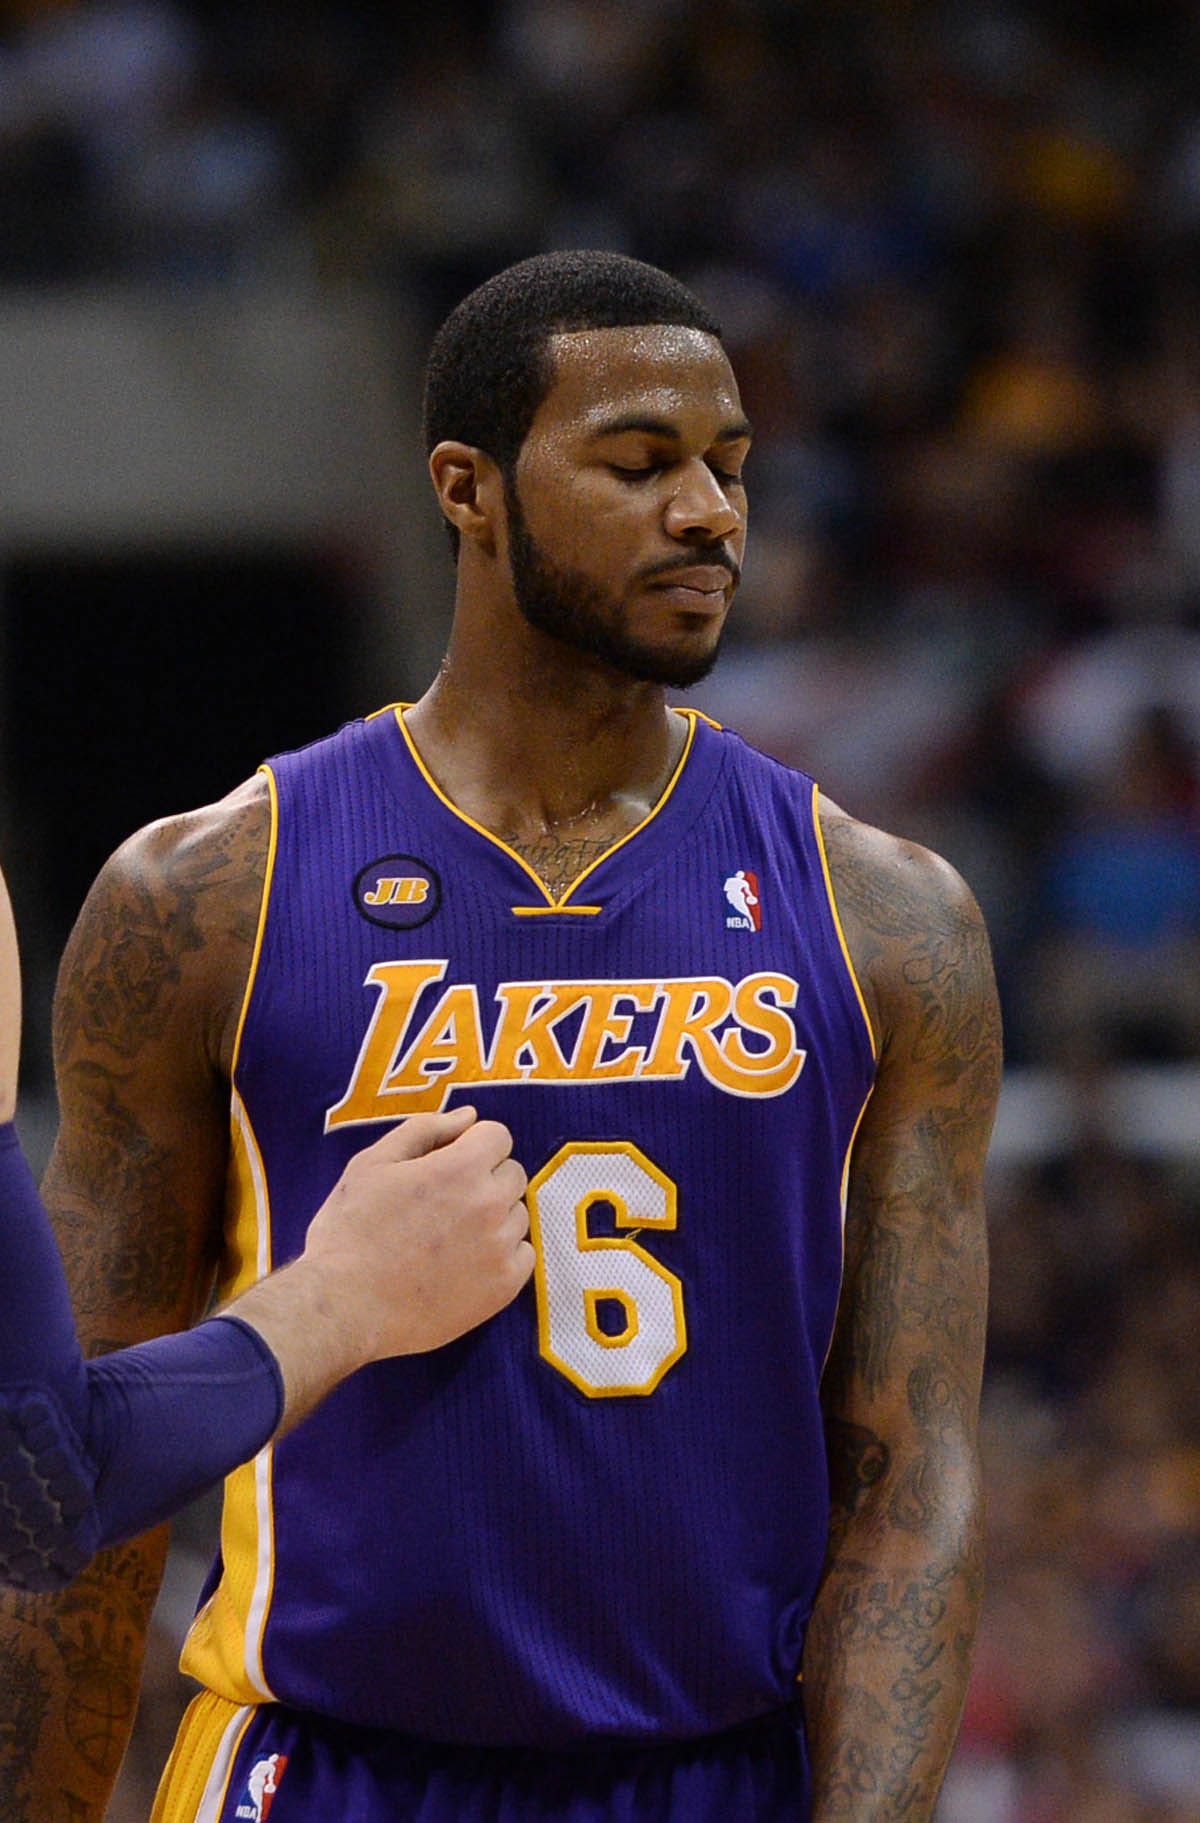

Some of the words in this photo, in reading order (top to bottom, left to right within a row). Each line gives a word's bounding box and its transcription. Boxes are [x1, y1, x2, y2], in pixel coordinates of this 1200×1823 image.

[363, 877, 430, 905] JB
[725, 916, 751, 929] NBA
[323, 958, 807, 1135] LAKERS
[527, 1141, 688, 1399] 6
[234, 1804, 258, 1820] NBA
